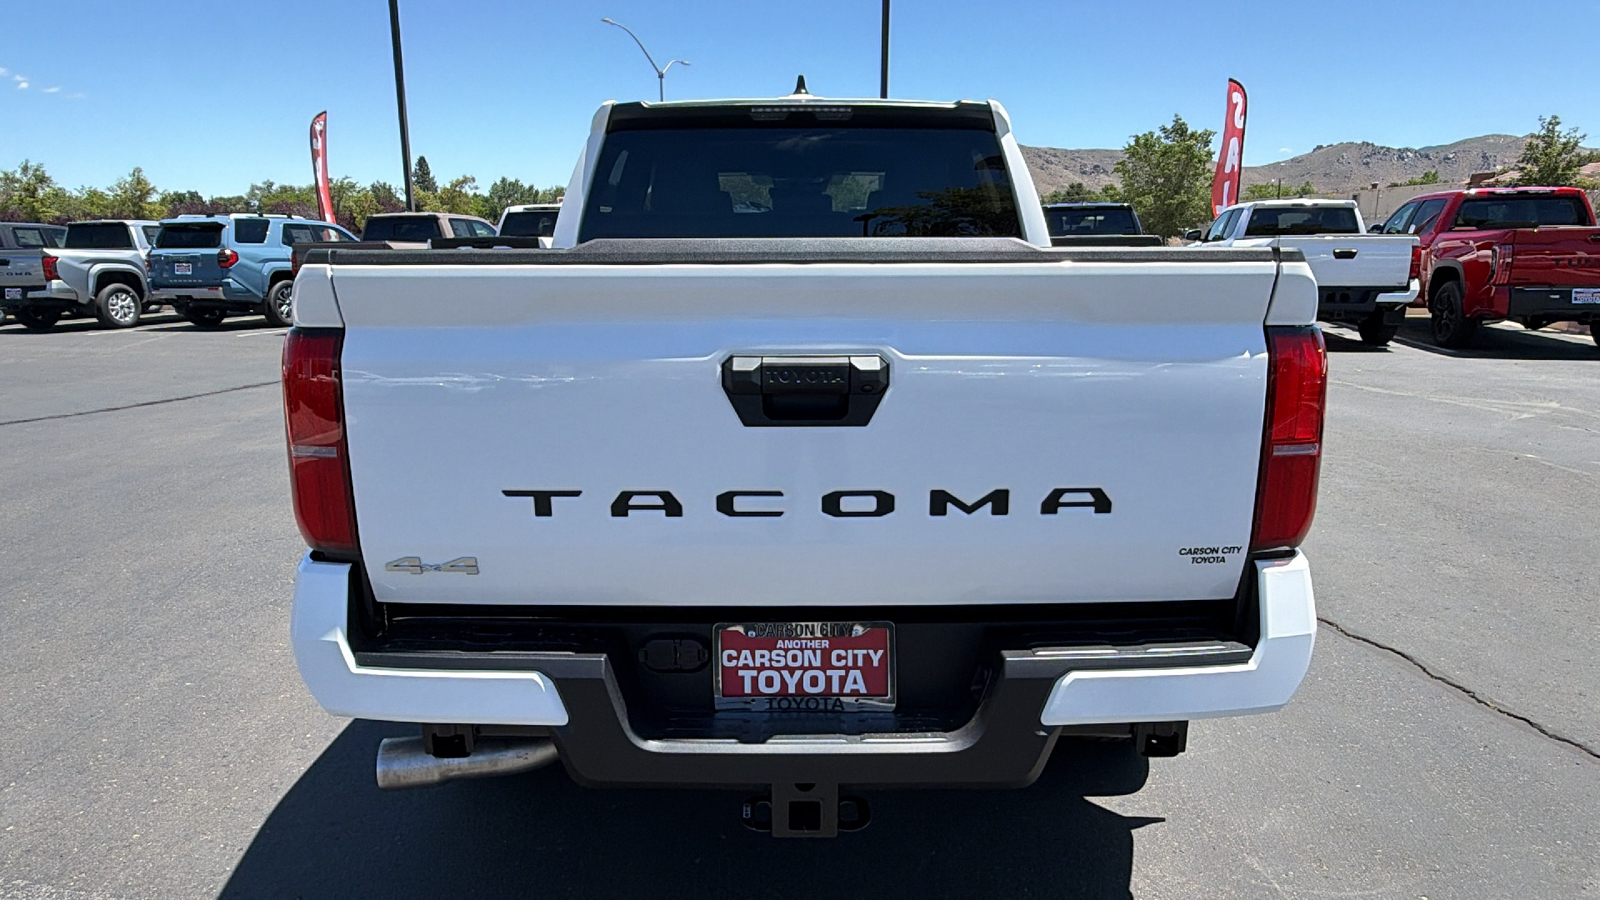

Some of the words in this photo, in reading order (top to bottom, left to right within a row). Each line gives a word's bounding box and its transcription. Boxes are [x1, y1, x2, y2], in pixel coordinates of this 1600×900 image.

[766, 370, 845, 383] TOYOTA
[501, 487, 1113, 518] TACOMA
[1178, 547, 1220, 556] CARSON
[1221, 546, 1243, 554] CITY
[1191, 556, 1226, 564] TOYOTA
[756, 622, 815, 637] CARSON
[819, 621, 852, 636] CITY
[776, 639, 830, 649] ANOTHER
[722, 650, 822, 667] CARSON
[831, 649, 884, 667] CITY
[738, 669, 868, 694] TOYOTA
[765, 697, 845, 711] TOYOTA
